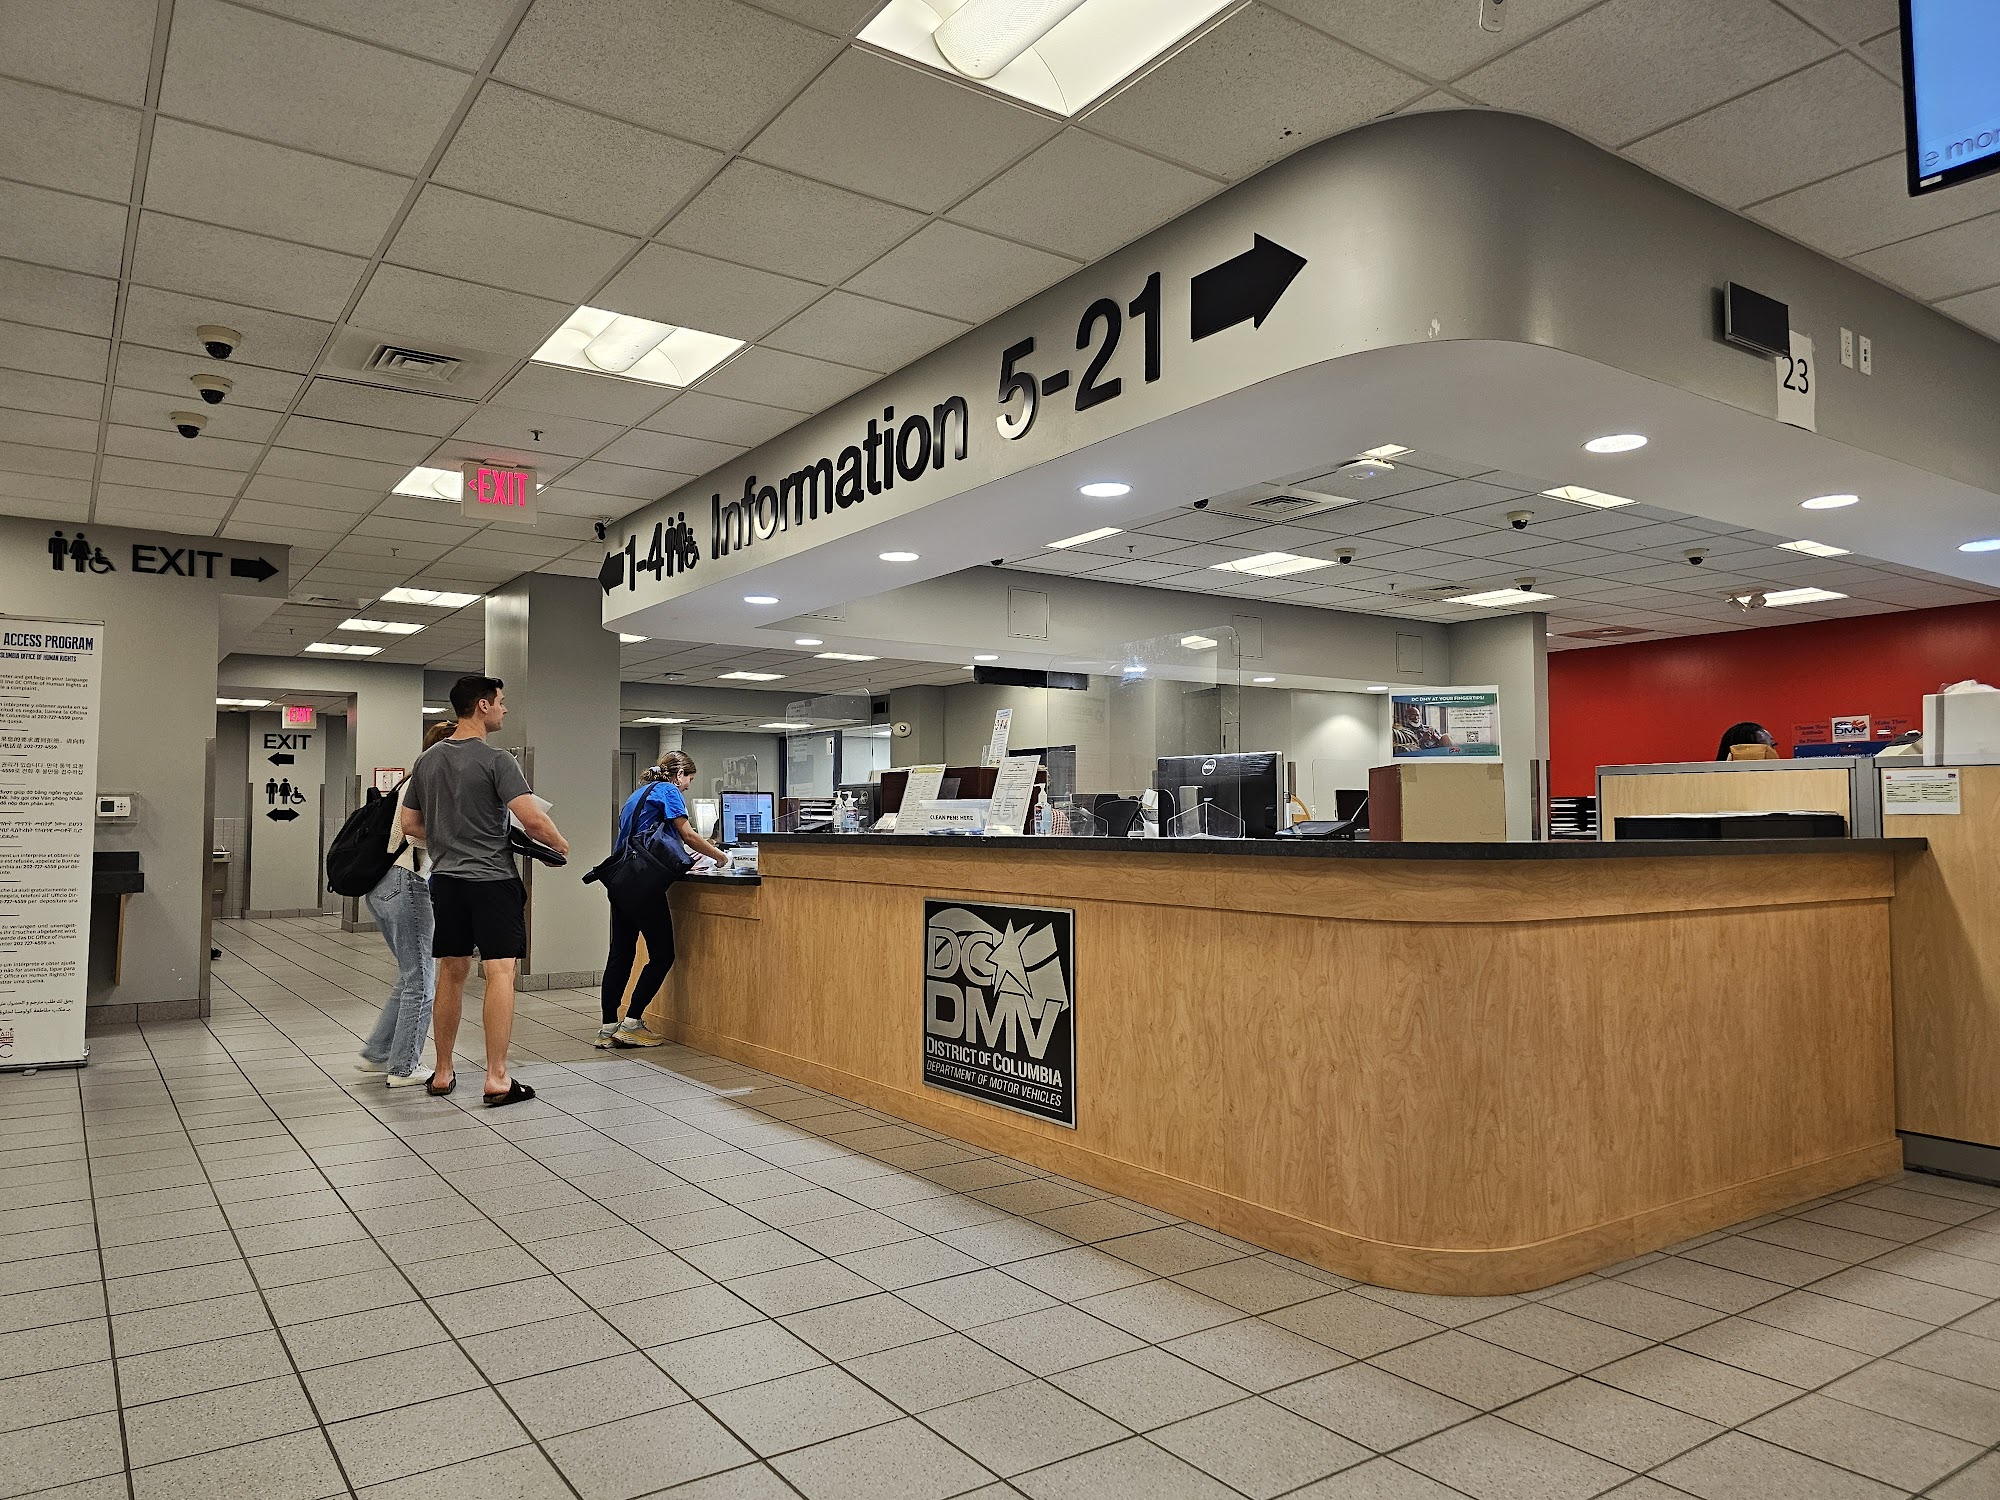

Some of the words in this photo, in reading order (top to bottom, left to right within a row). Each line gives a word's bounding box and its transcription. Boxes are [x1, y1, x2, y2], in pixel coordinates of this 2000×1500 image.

[996, 271, 1161, 440] 5-21
[1782, 356, 1809, 394] 23
[478, 468, 528, 507] EXIT
[711, 394, 969, 560] Information
[132, 544, 223, 578] EXIT
[624, 522, 665, 592] 1-4
[3, 632, 42, 647] ACCESS
[45, 635, 94, 651] PROGRAM
[289, 706, 313, 722] EXIT
[263, 733, 312, 750] EXIT
[927, 926, 995, 987] DC
[926, 978, 1064, 1060] DMV
[926, 1035, 977, 1065] DISTRICT
[978, 1050, 992, 1066] OF
[992, 1052, 1063, 1088] COLUMBIA
[926, 1059, 977, 1083] DEPARTMENT
[977, 1073, 988, 1086] OF
[988, 1076, 1020, 1096] MOTOR
[1021, 1084, 1062, 1107] VEHICLES
